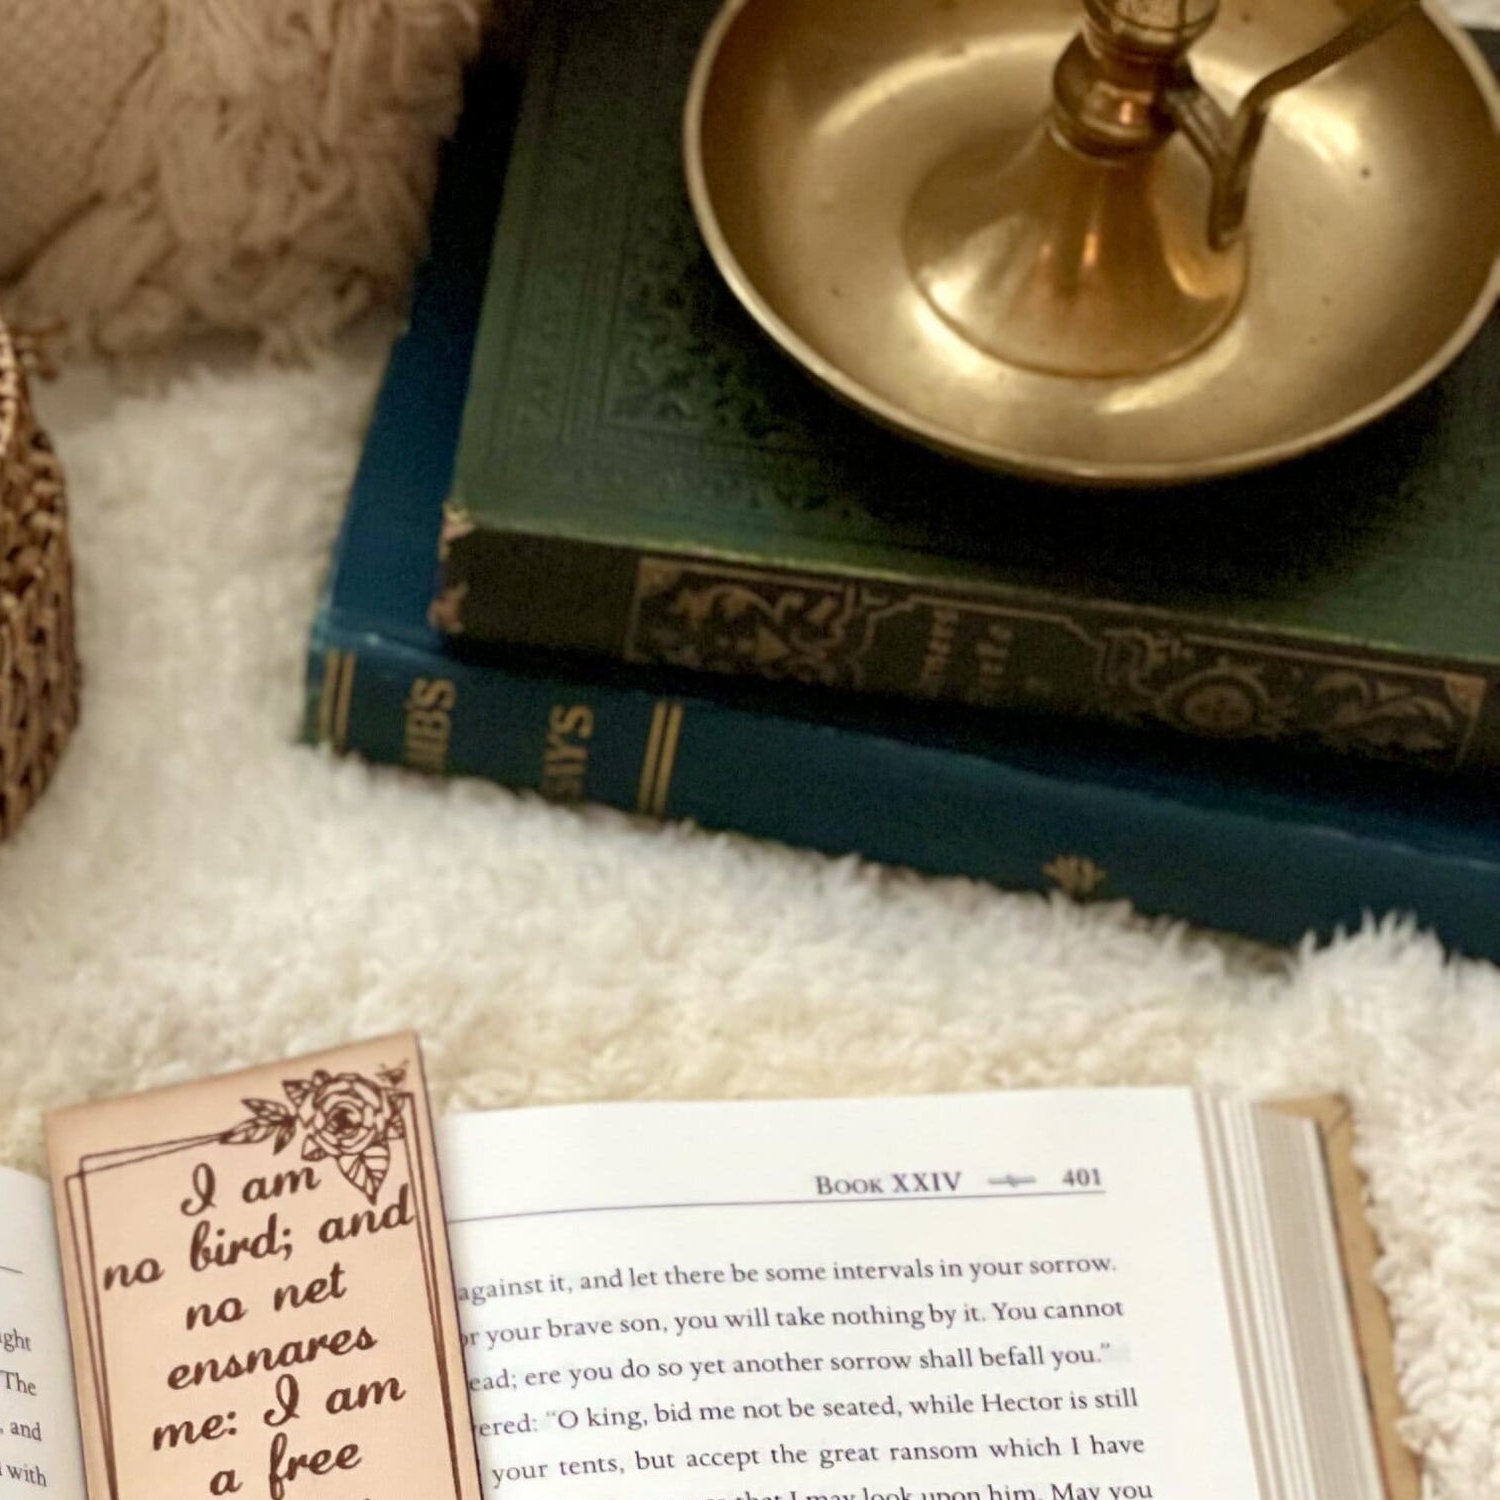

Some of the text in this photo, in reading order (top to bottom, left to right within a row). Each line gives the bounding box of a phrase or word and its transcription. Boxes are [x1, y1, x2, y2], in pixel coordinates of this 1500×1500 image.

[180, 1162, 322, 1217] I am
[891, 1170, 962, 1194] XXIV
[1061, 1167, 1102, 1187] 401
[103, 1183, 414, 1291] no bird; and
[185, 1261, 348, 1331] no net
[457, 1258, 1116, 1307] against it, and let there be some intervals in your sorrow.
[166, 1325, 379, 1391] ensnares
[152, 1373, 407, 1452] me: I am
[209, 1432, 362, 1499] a free
[491, 1434, 1145, 1490] your tents, but accept the great ransom which I have
